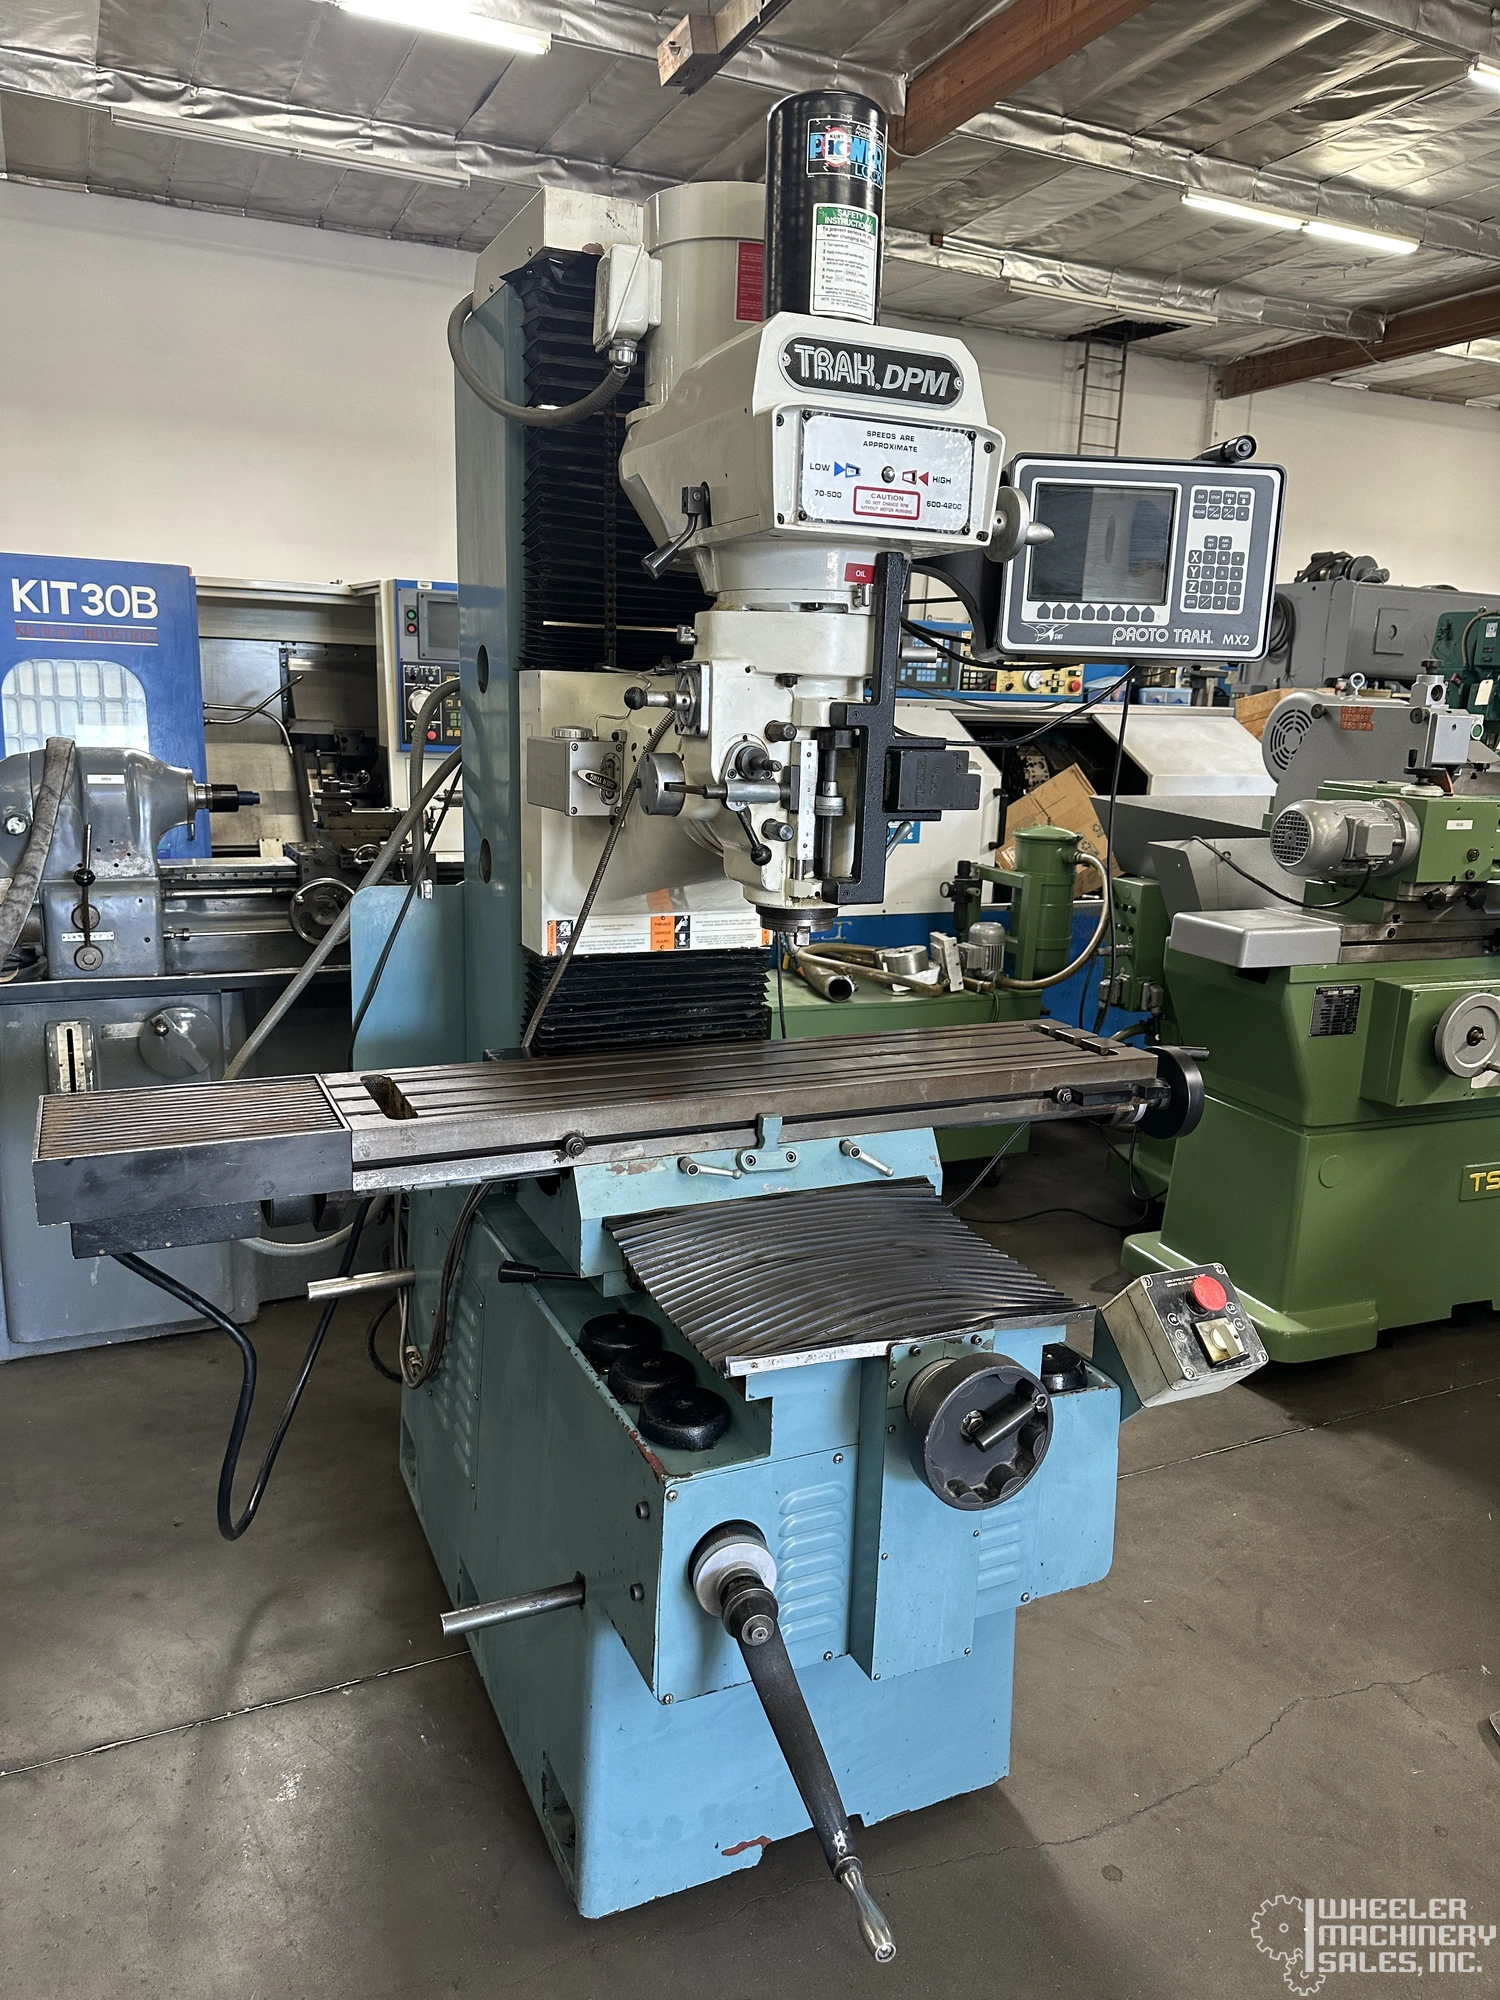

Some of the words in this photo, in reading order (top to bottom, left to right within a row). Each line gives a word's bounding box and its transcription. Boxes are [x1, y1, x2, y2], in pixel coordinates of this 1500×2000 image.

[837, 209, 864, 220] SAFETY
[824, 216, 874, 233] INSTRUCTIO
[882, 364, 951, 397] DPM
[866, 430, 896, 440] SPEEDS
[862, 440, 918, 452] APPROXIMATE
[810, 462, 830, 472] LOW
[932, 476, 952, 484] HIGH
[814, 489, 842, 499] 70-500
[870, 493, 904, 502] CAUTION
[1191, 552, 1199, 562] X
[1190, 567, 1198, 577] Y
[1188, 582, 1196, 592] Z
[12, 578, 158, 620] KIT30B
[16, 624, 36, 636] KIA
[40, 626, 80, 638] HEAVY
[82, 627, 159, 642] INDUSTRIES
[1222, 634, 1250, 646] MX2
